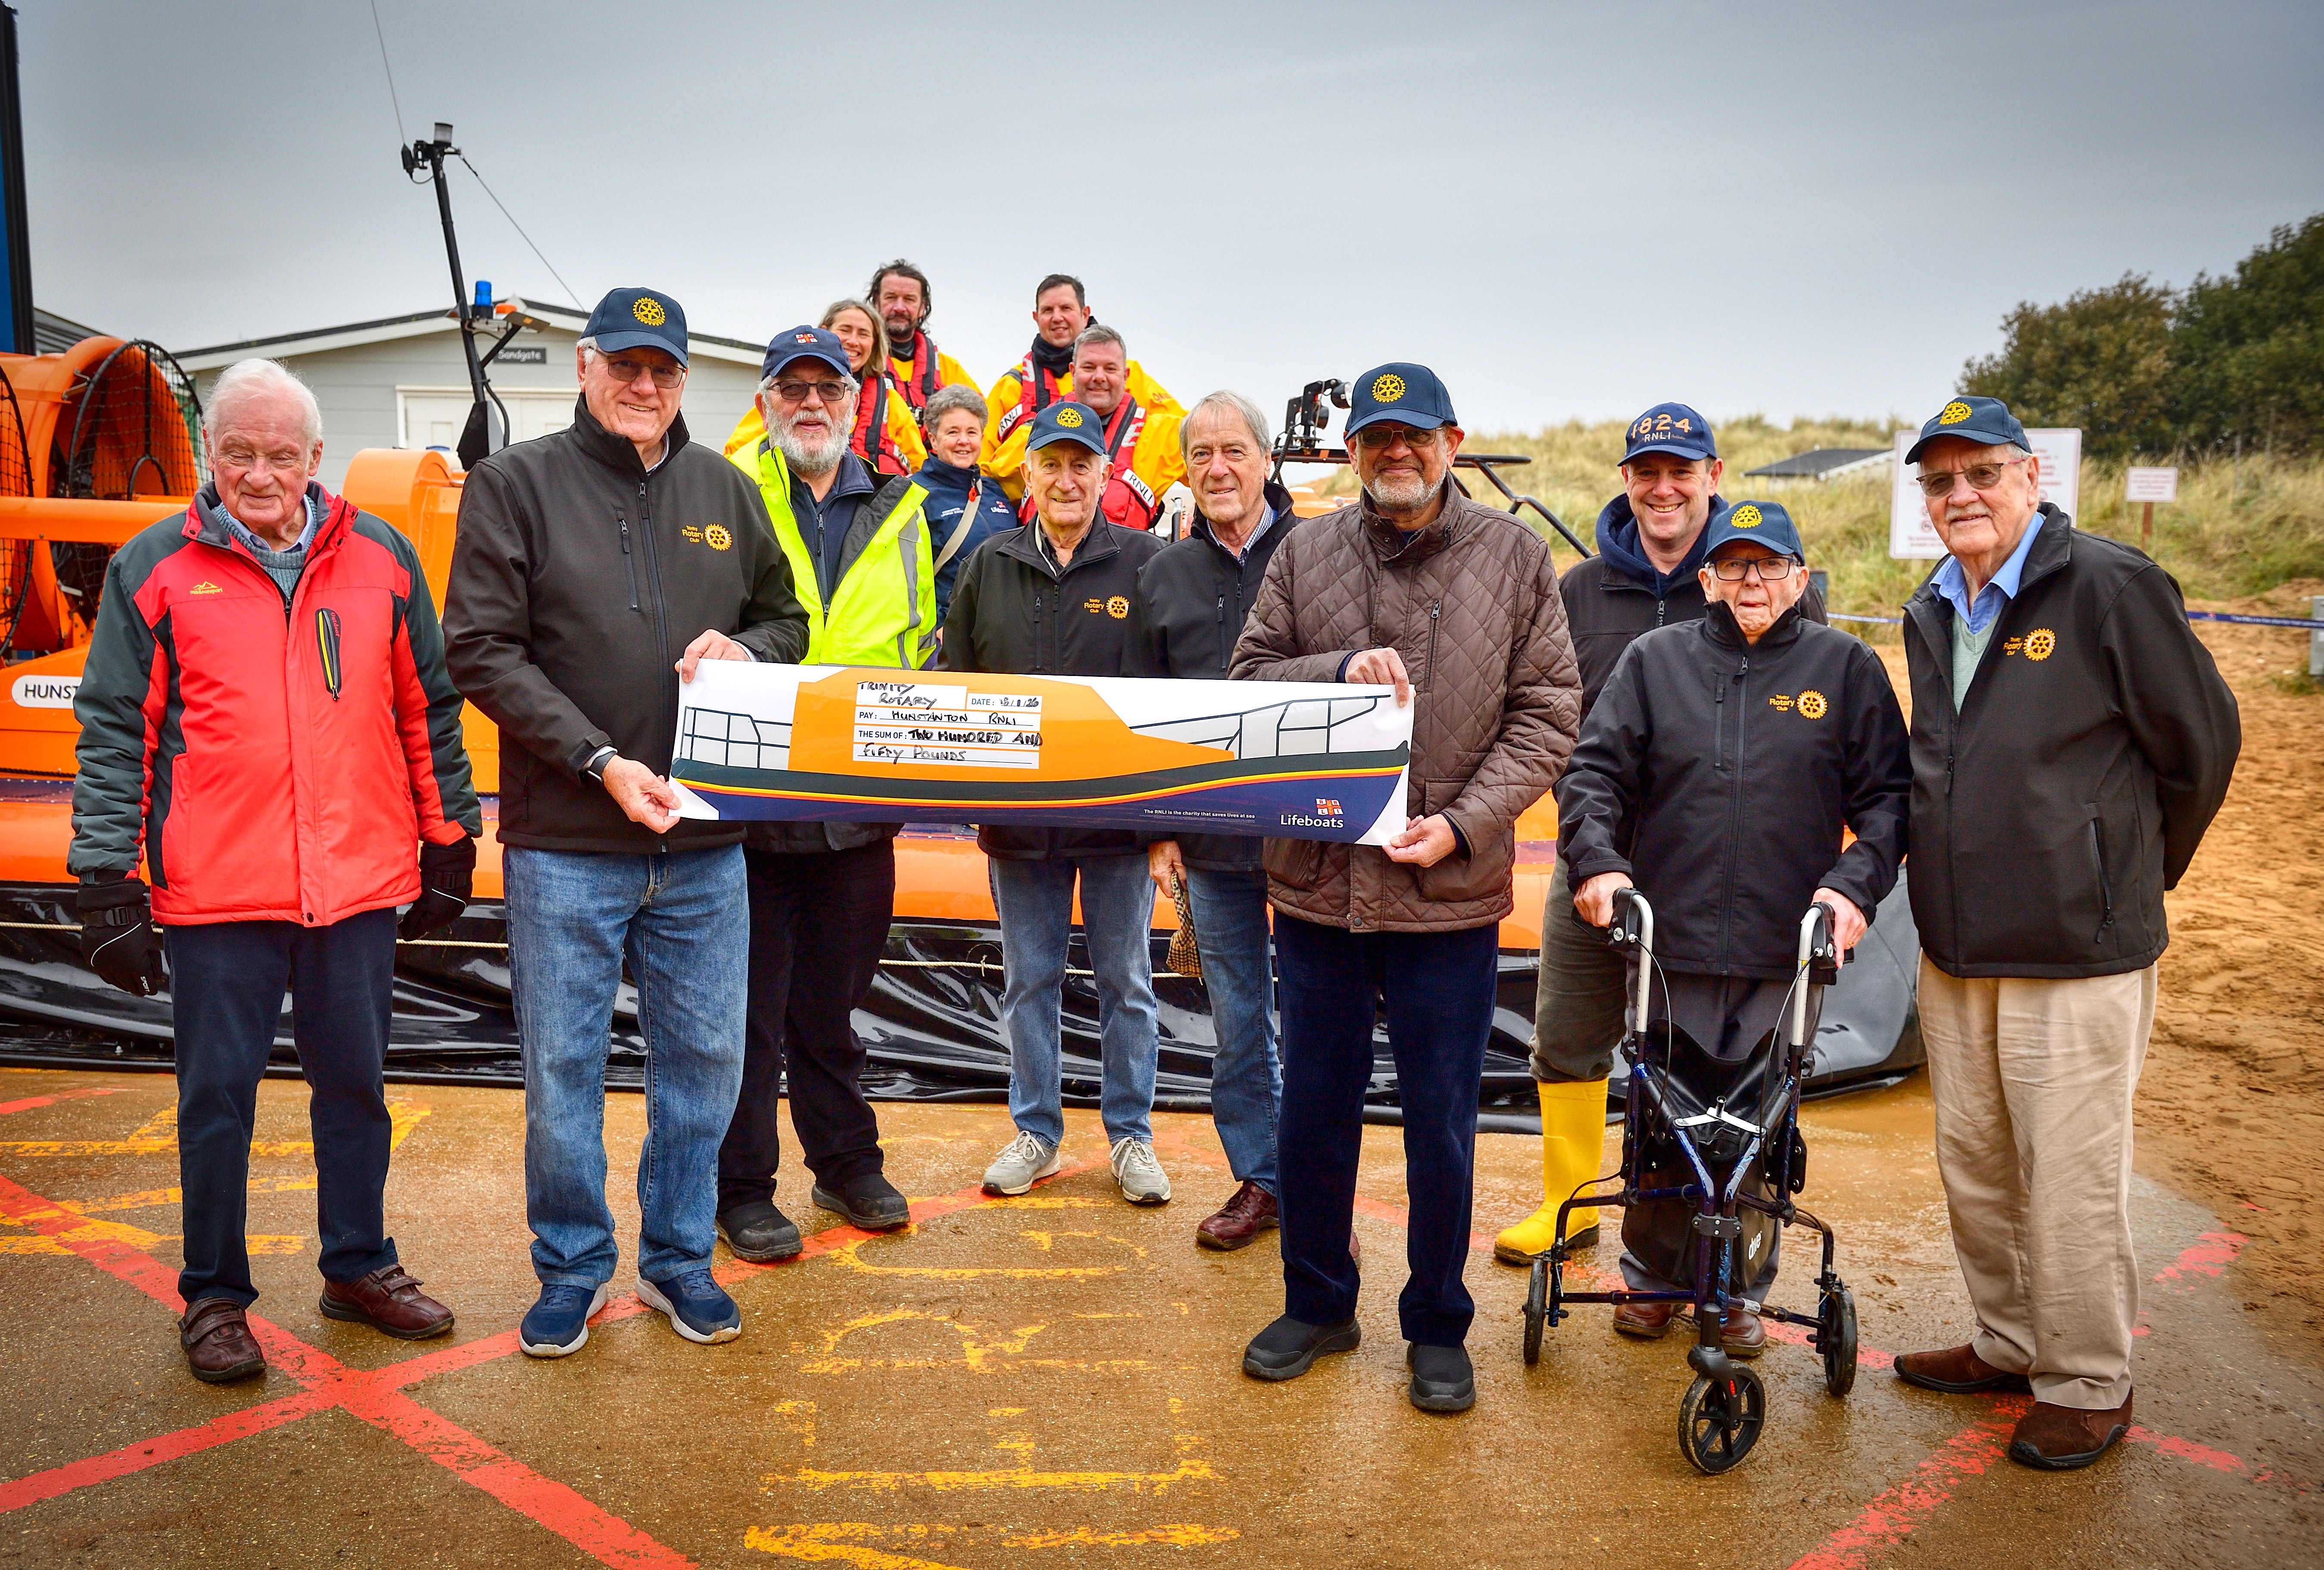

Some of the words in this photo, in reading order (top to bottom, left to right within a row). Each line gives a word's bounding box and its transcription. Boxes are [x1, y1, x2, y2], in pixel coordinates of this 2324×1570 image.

[497, 349, 542, 362] Sandgate
[999, 408, 1018, 432] RNLI
[1632, 414, 1690, 439] 1824
[1644, 431, 1671, 442] RNLI
[1129, 474, 1153, 502] RNLI
[682, 529, 704, 539] Rotary
[857, 681, 915, 695] TRINITY
[879, 693, 937, 710] ROTARY
[971, 698, 995, 706] DATE:
[1769, 698, 1795, 707] Rotary
[892, 711, 968, 723] HUNSTANTON
[989, 712, 1016, 726] RNLI
[908, 729, 934, 740] TWO
[938, 731, 1003, 744] HUNDRED
[1012, 732, 1044, 748] AND
[913, 745, 967, 761] POUNDS
[1280, 814, 1344, 829] Lifeboats
